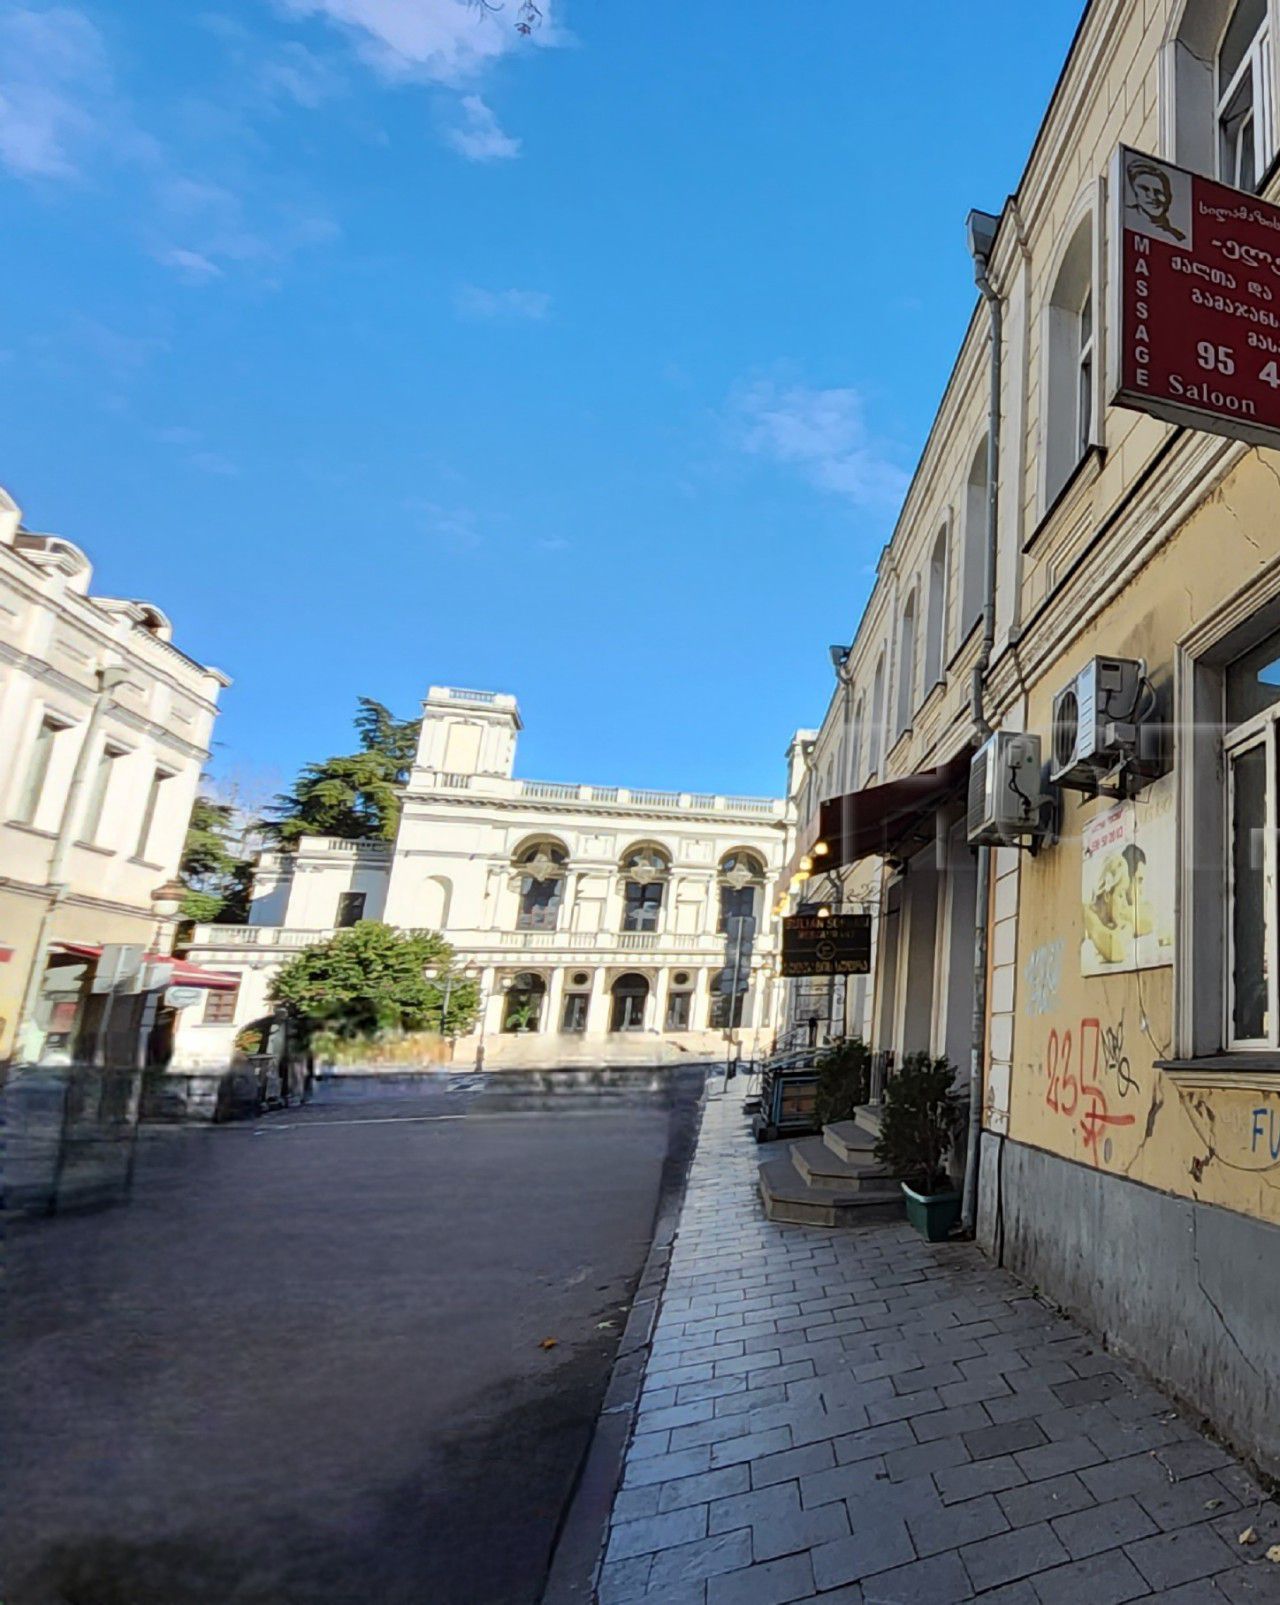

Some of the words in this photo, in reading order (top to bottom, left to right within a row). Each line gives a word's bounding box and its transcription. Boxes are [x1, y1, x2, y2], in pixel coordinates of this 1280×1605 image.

[1247, 281, 1273, 301] და
[1133, 234, 1150, 387] MASSAGE
[1196, 341, 1236, 375] 95
[1168, 374, 1257, 415] Saloon
